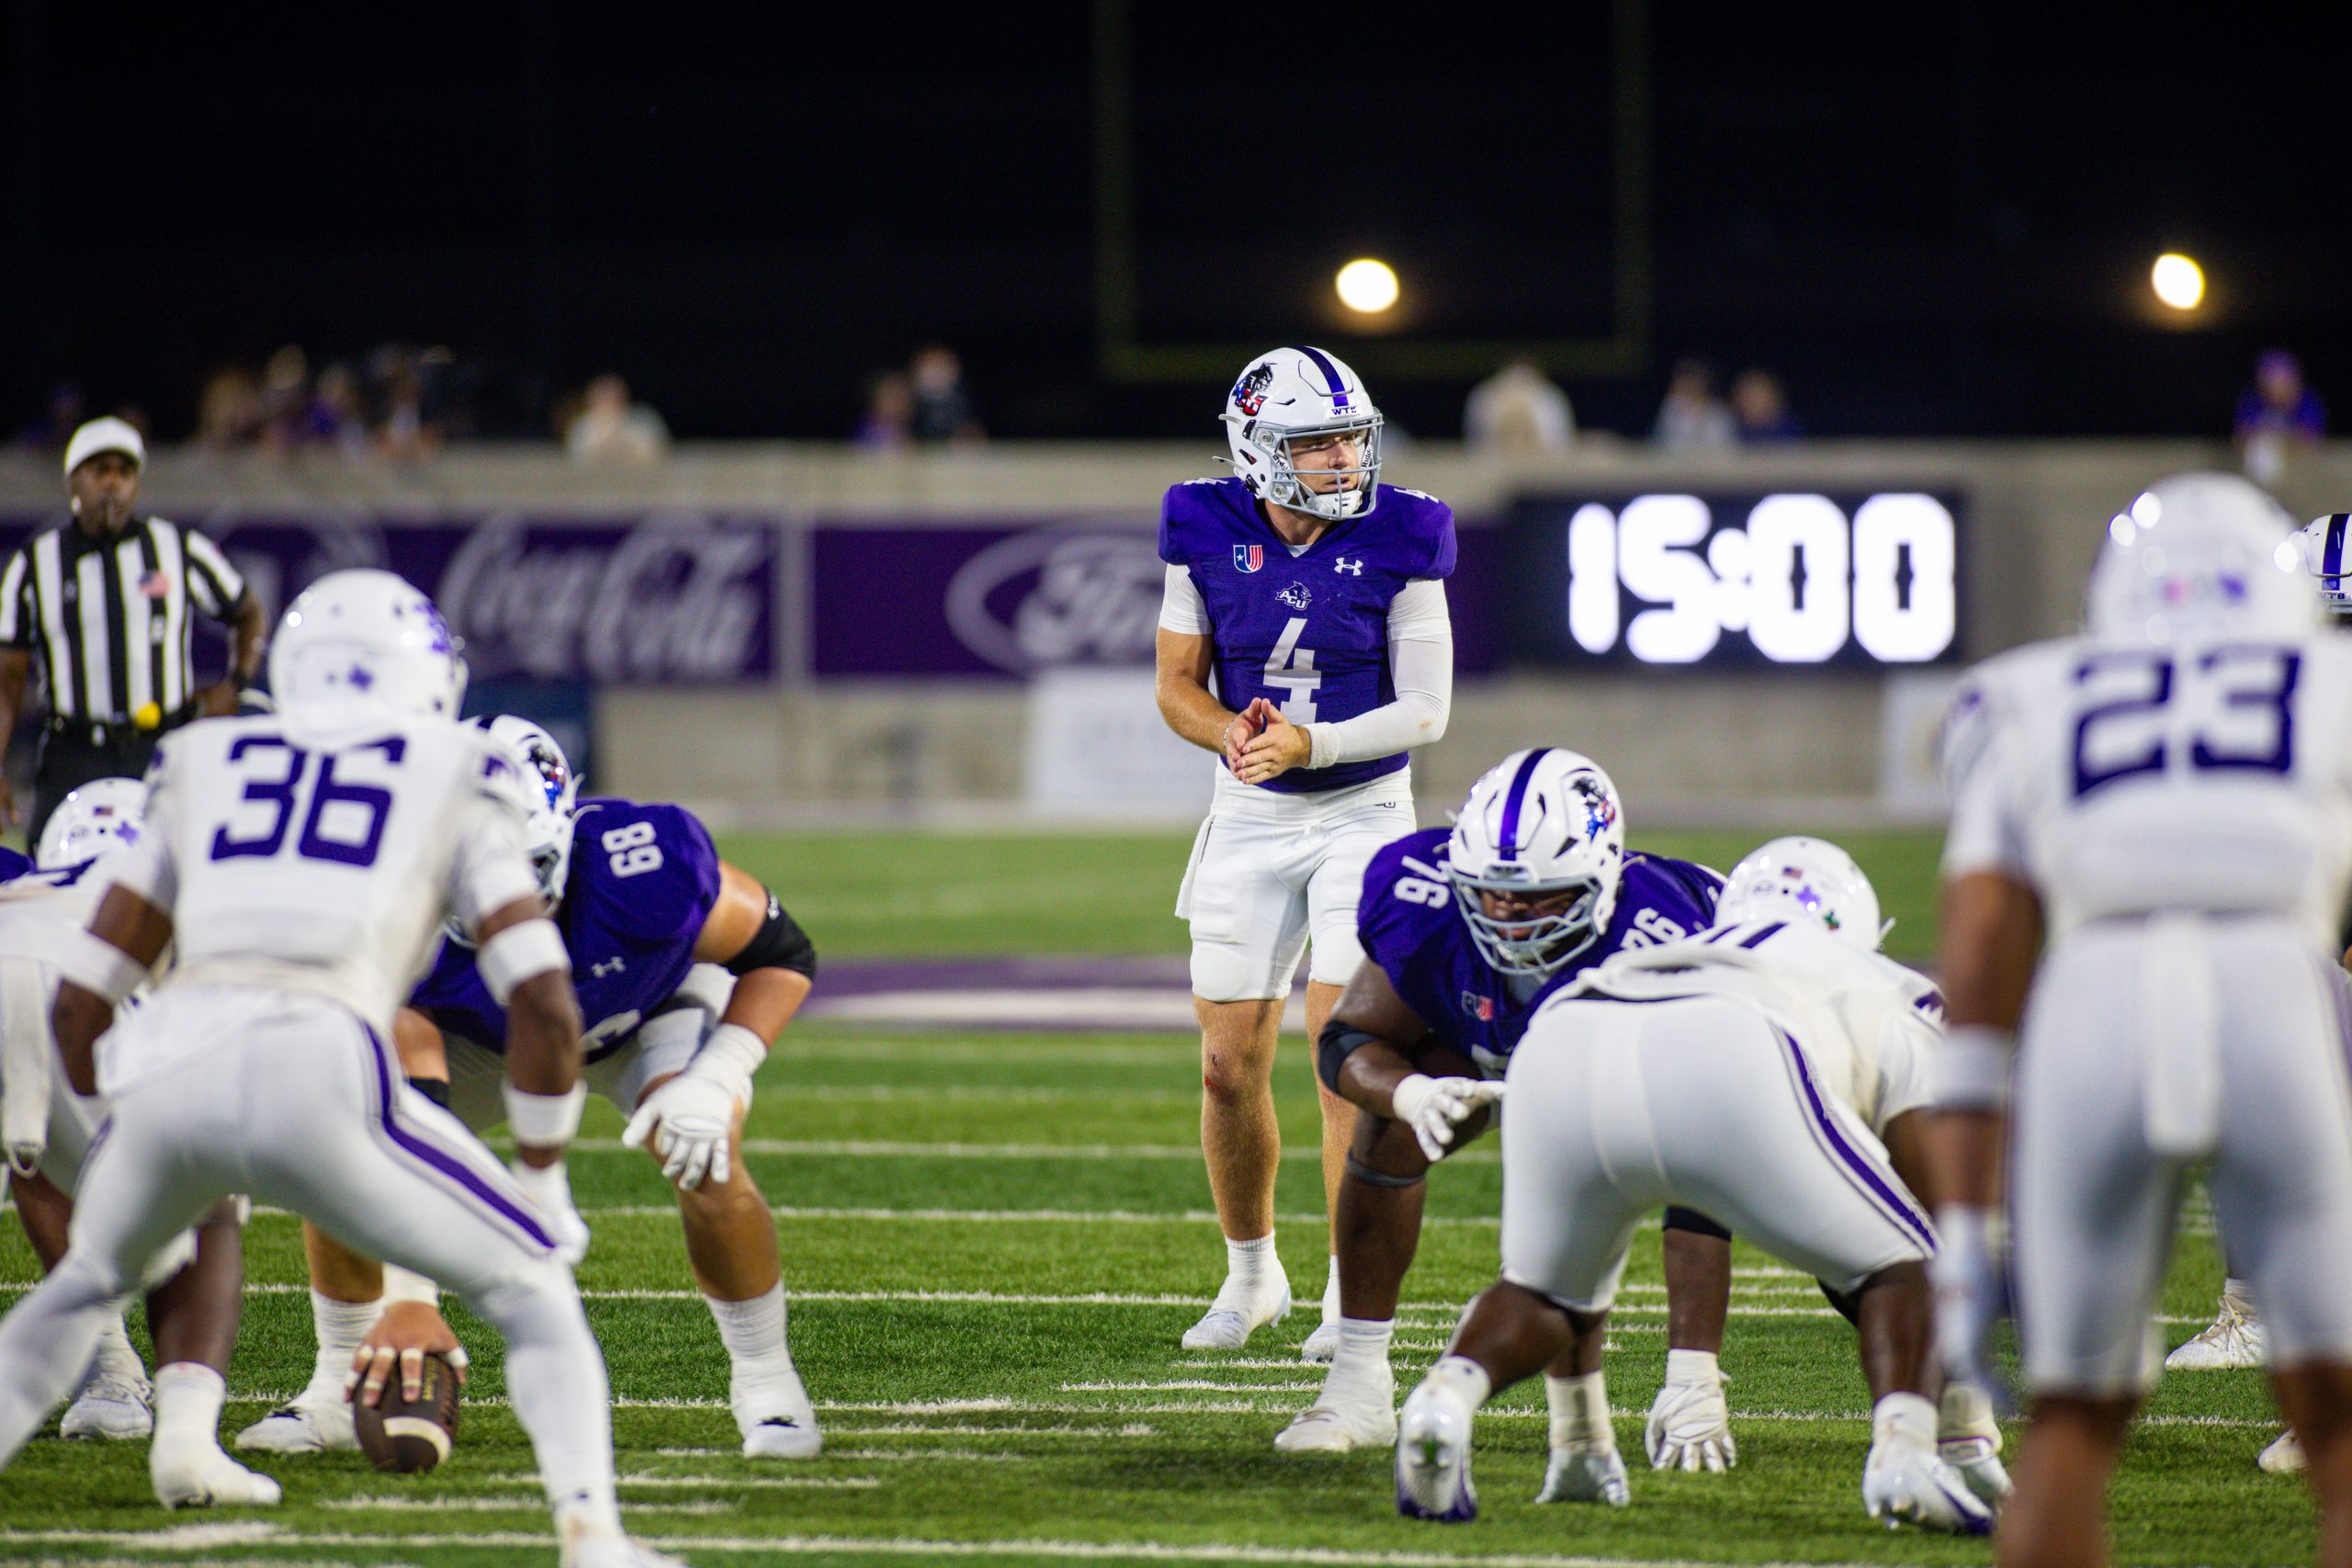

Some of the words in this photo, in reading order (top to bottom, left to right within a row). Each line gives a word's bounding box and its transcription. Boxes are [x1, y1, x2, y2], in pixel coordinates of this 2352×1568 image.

[1277, 589, 1309, 609] ACU
[1569, 493, 1955, 662] 15:00
[1262, 616, 1322, 725] 4
[2070, 645, 2302, 797] 23
[210, 736, 406, 867] 36
[601, 820, 664, 879] 68
